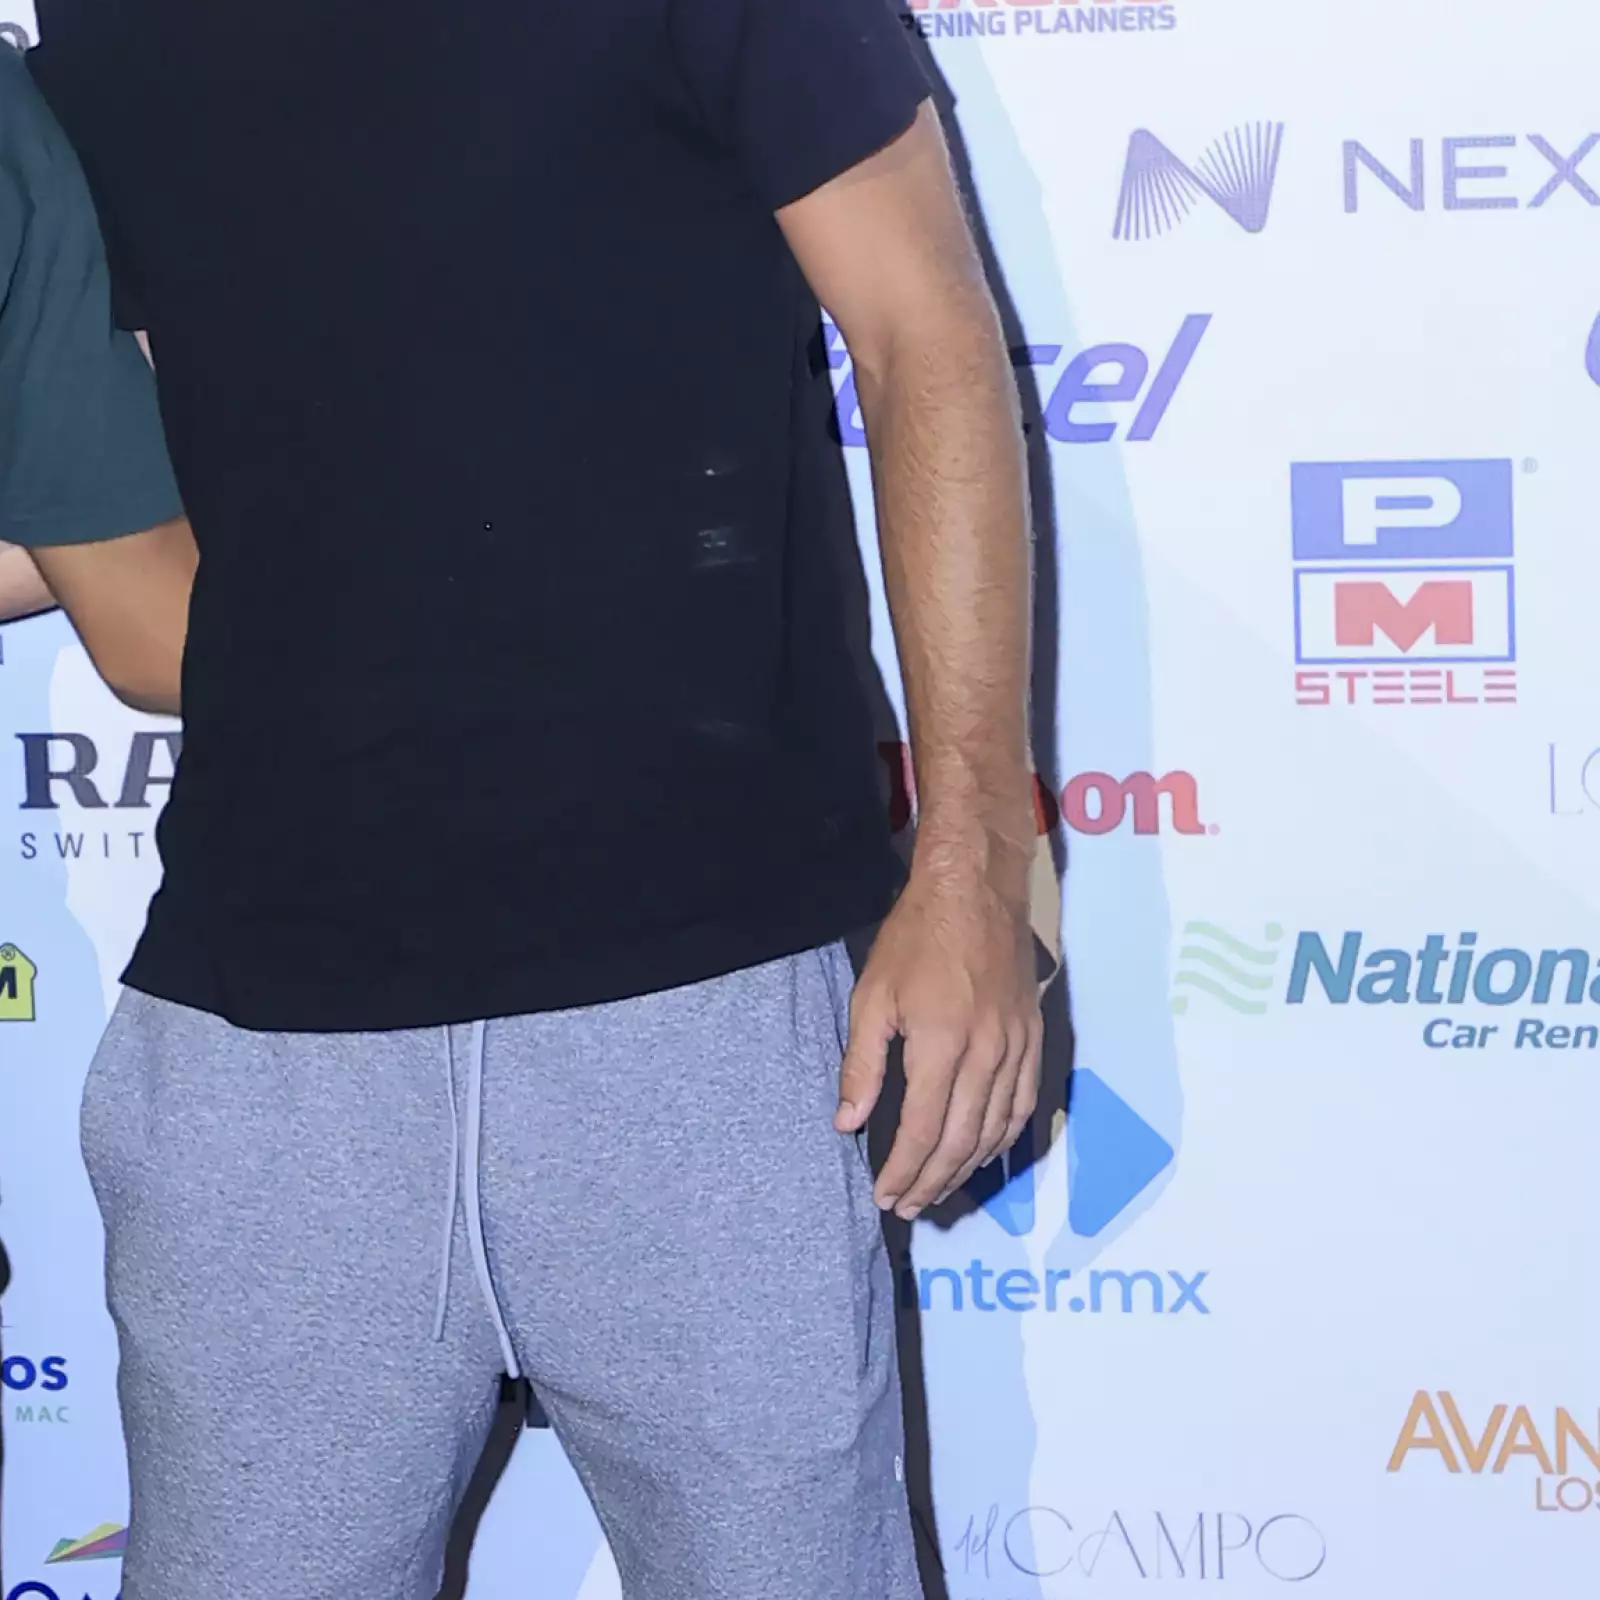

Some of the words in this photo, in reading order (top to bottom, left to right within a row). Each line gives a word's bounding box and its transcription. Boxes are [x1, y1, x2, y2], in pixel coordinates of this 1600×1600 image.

[1014, 5, 1176, 36] PLANNERS
[1295, 670, 1517, 705] STEELE
[1422, 1018, 1498, 1049] Car
[16, 1405, 70, 1425] MAC
[1004, 1504, 1326, 1583] CAMPO
